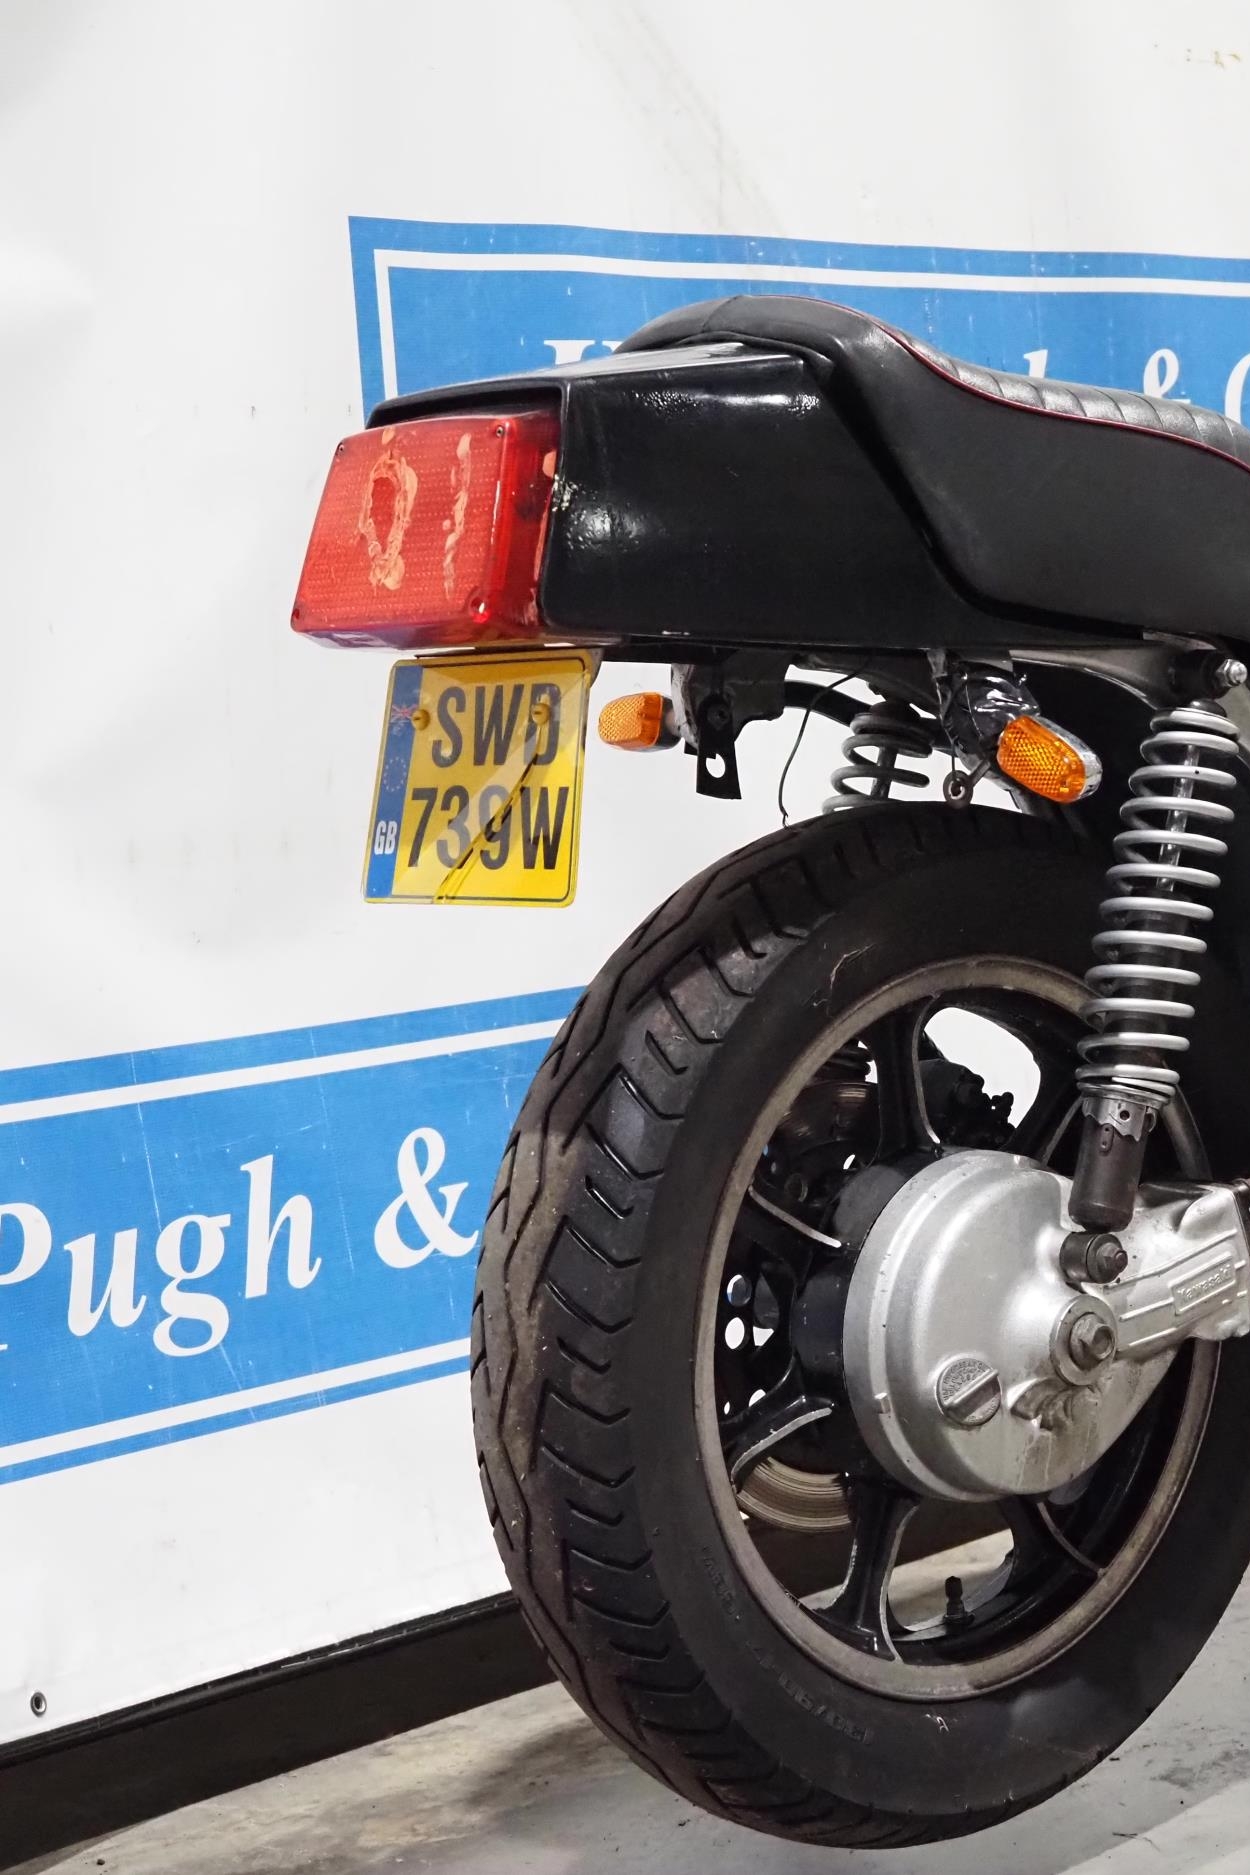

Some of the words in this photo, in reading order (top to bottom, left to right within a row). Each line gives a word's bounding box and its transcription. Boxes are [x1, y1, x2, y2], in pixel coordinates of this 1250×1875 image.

[431, 683, 562, 767] SWD
[374, 820, 397, 855] GB
[407, 784, 570, 870] 739W
[373, 1126, 479, 1268] &
